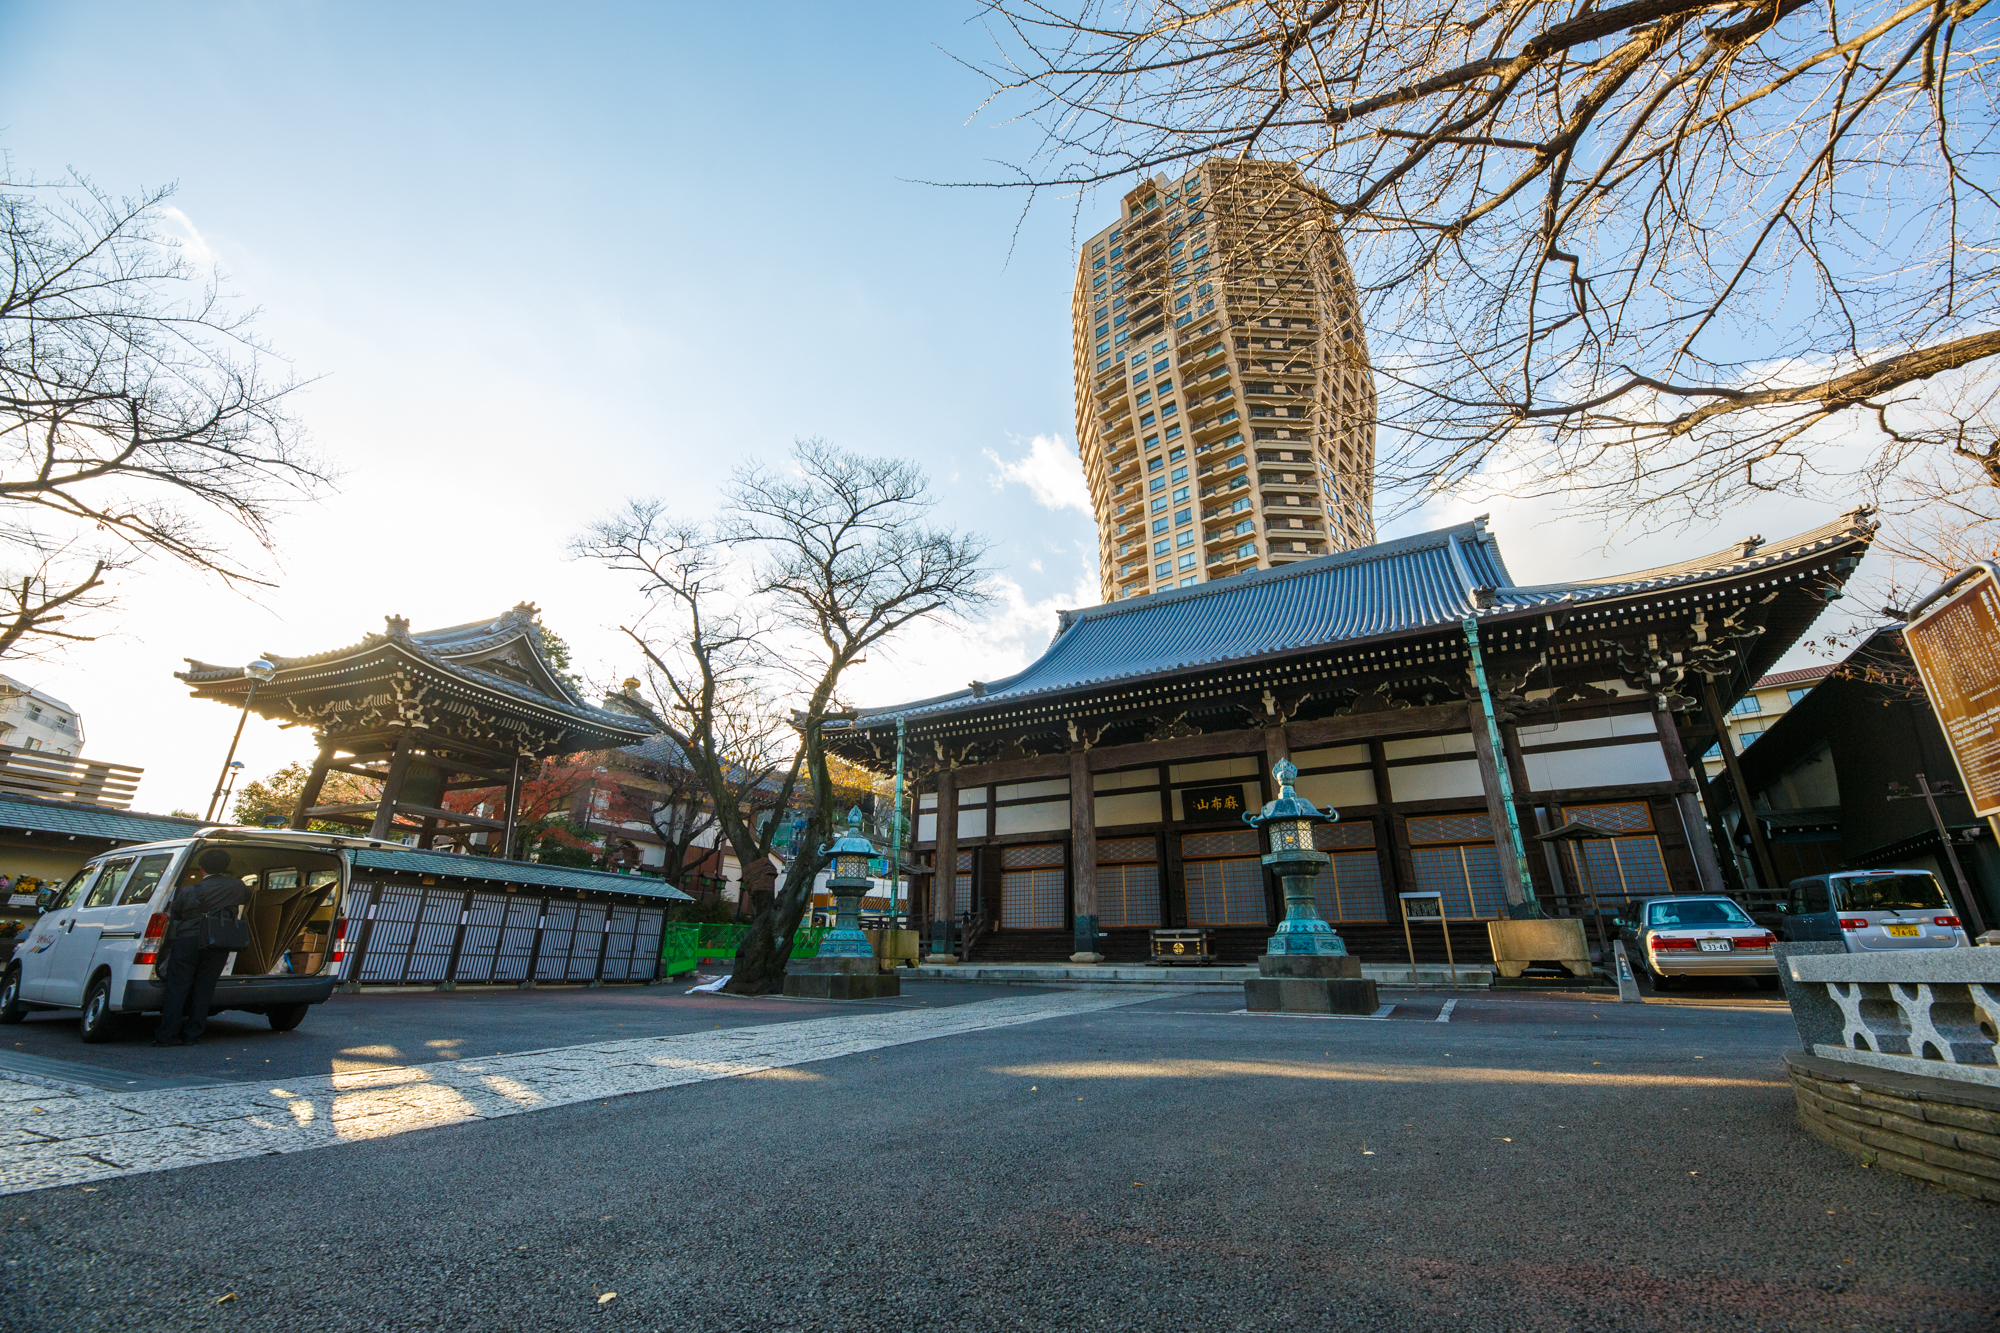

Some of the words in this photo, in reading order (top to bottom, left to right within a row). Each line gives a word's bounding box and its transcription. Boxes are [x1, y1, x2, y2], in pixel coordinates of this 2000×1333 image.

[1970, 712, 1987, 724] America
[1962, 726, 1975, 737] place
[1974, 721, 1980, 730] of
